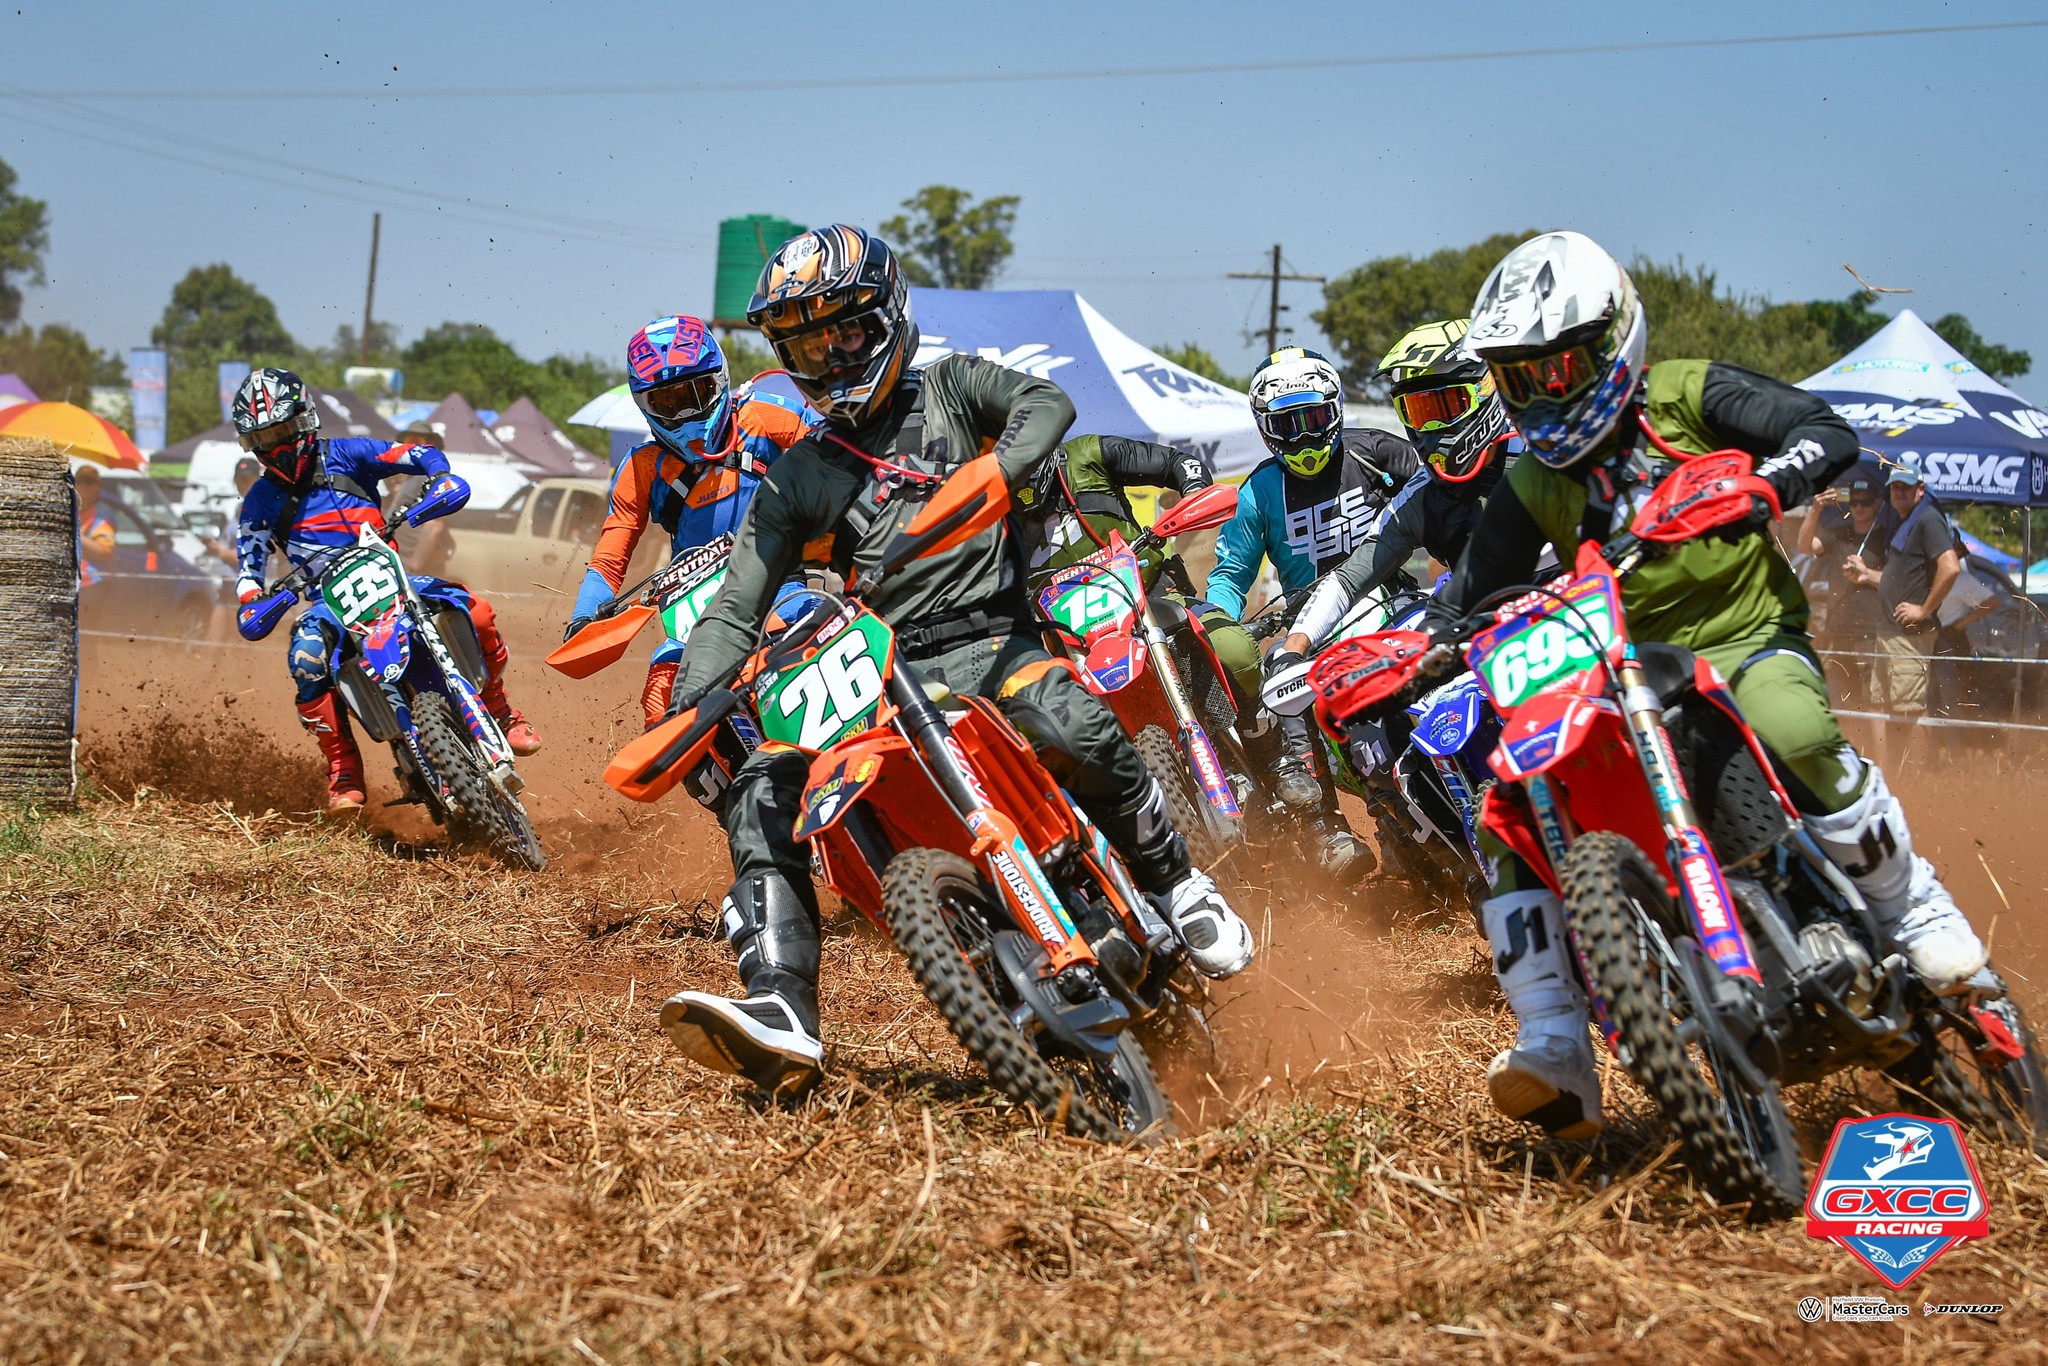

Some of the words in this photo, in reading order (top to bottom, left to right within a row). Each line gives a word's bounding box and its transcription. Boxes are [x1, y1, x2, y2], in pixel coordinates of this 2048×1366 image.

[1833, 402, 1964, 425] ANS
[1989, 409, 2048, 439] VA
[1923, 452, 2026, 487] SSMG
[331, 553, 400, 626] 335
[657, 540, 731, 591] RENTHAL
[666, 554, 730, 606] ROOST
[1060, 573, 1126, 632] 15
[1491, 596, 1611, 707] 695
[779, 629, 884, 751] 26
[403, 730, 436, 785] DUNLOP
[1191, 740, 1222, 786] MOTUL
[992, 849, 1066, 949] BRIDGESTONE
[1684, 857, 1727, 928] MOTUL
